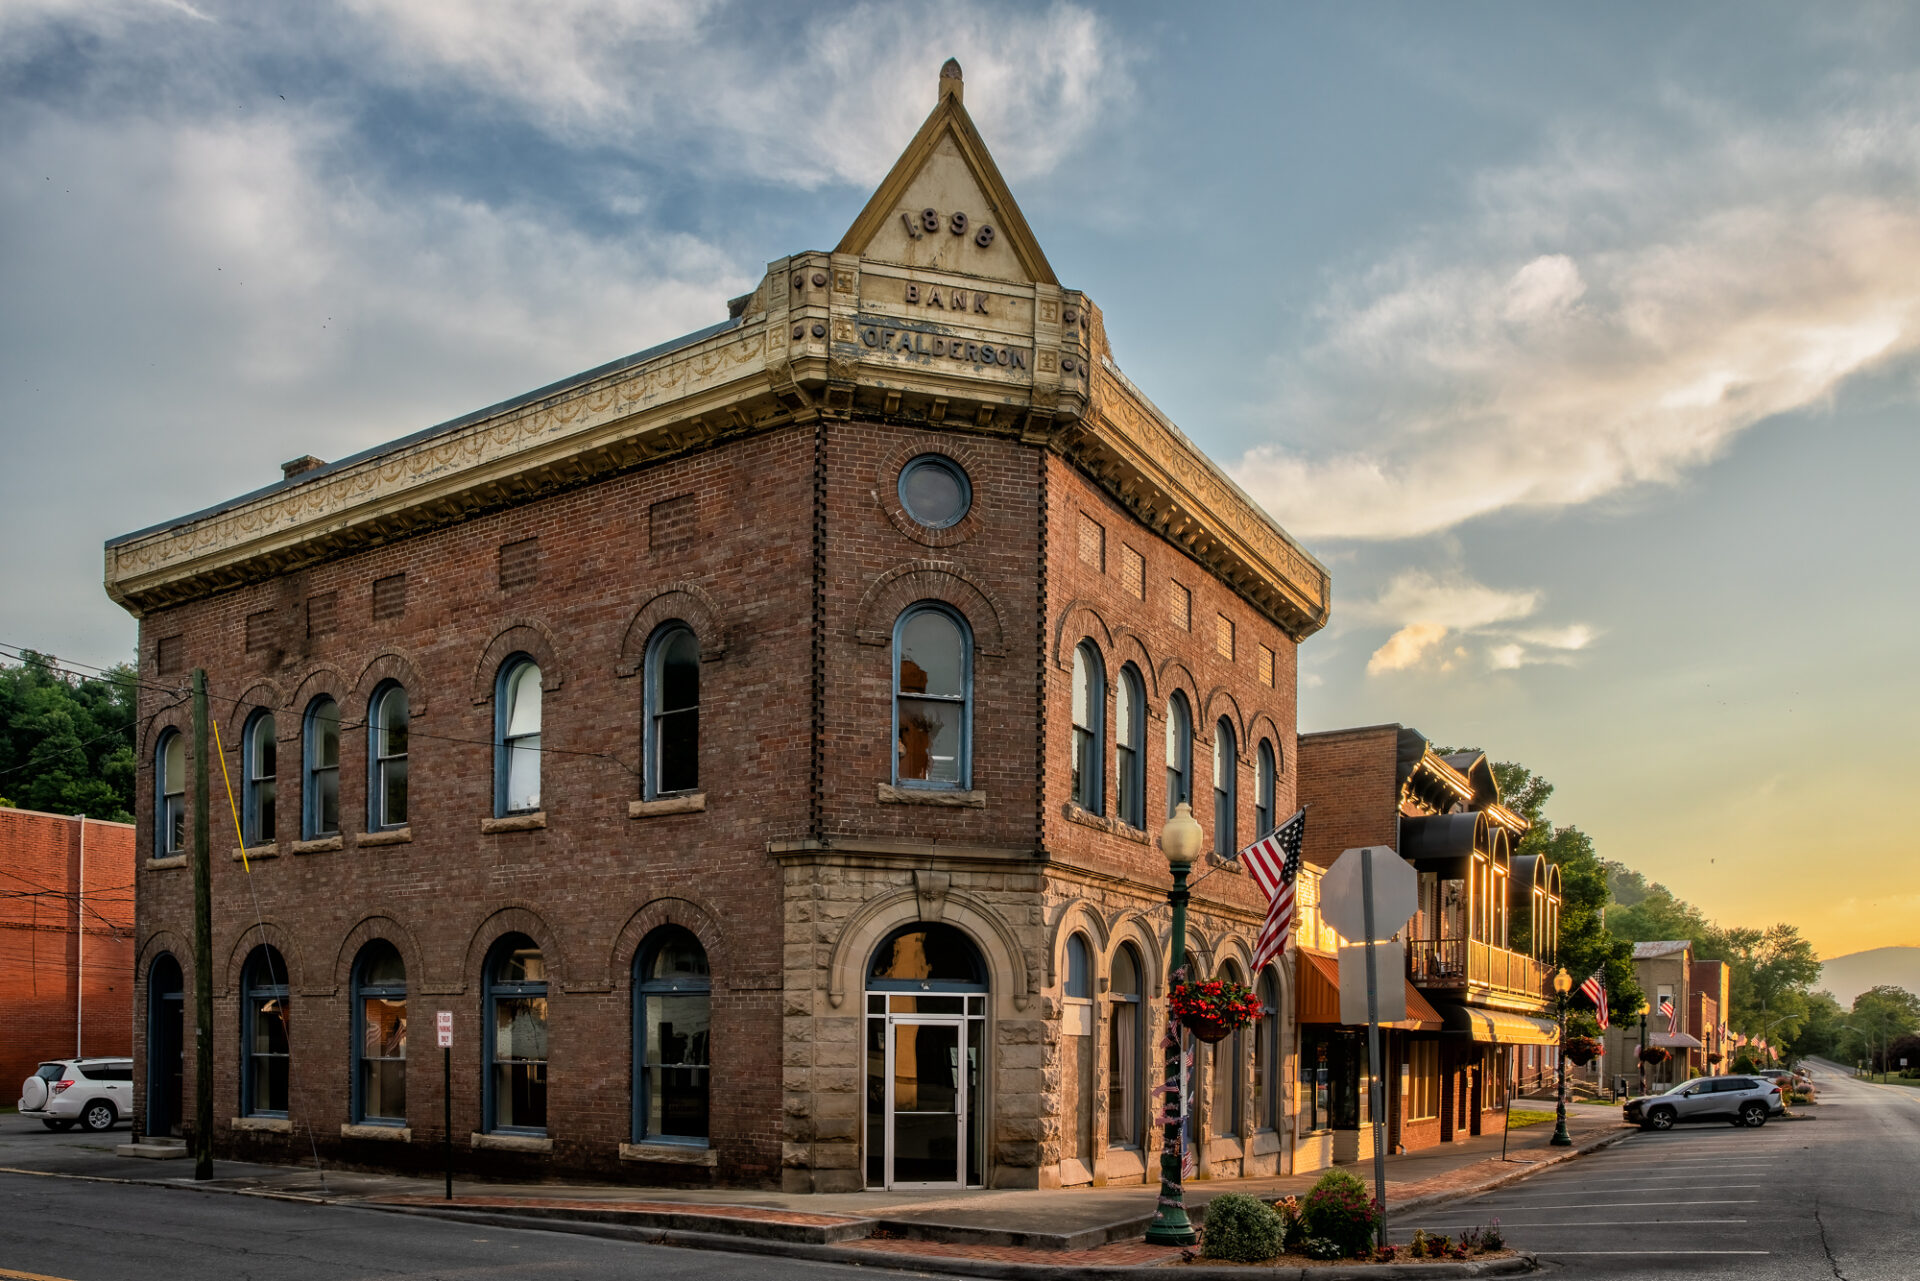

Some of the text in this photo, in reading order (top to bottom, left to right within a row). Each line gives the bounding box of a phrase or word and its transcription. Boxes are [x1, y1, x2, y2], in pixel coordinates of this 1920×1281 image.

[901, 207, 995, 248] 1898
[905, 281, 989, 314] BANK
[896, 332, 1027, 370] ALDERSON
